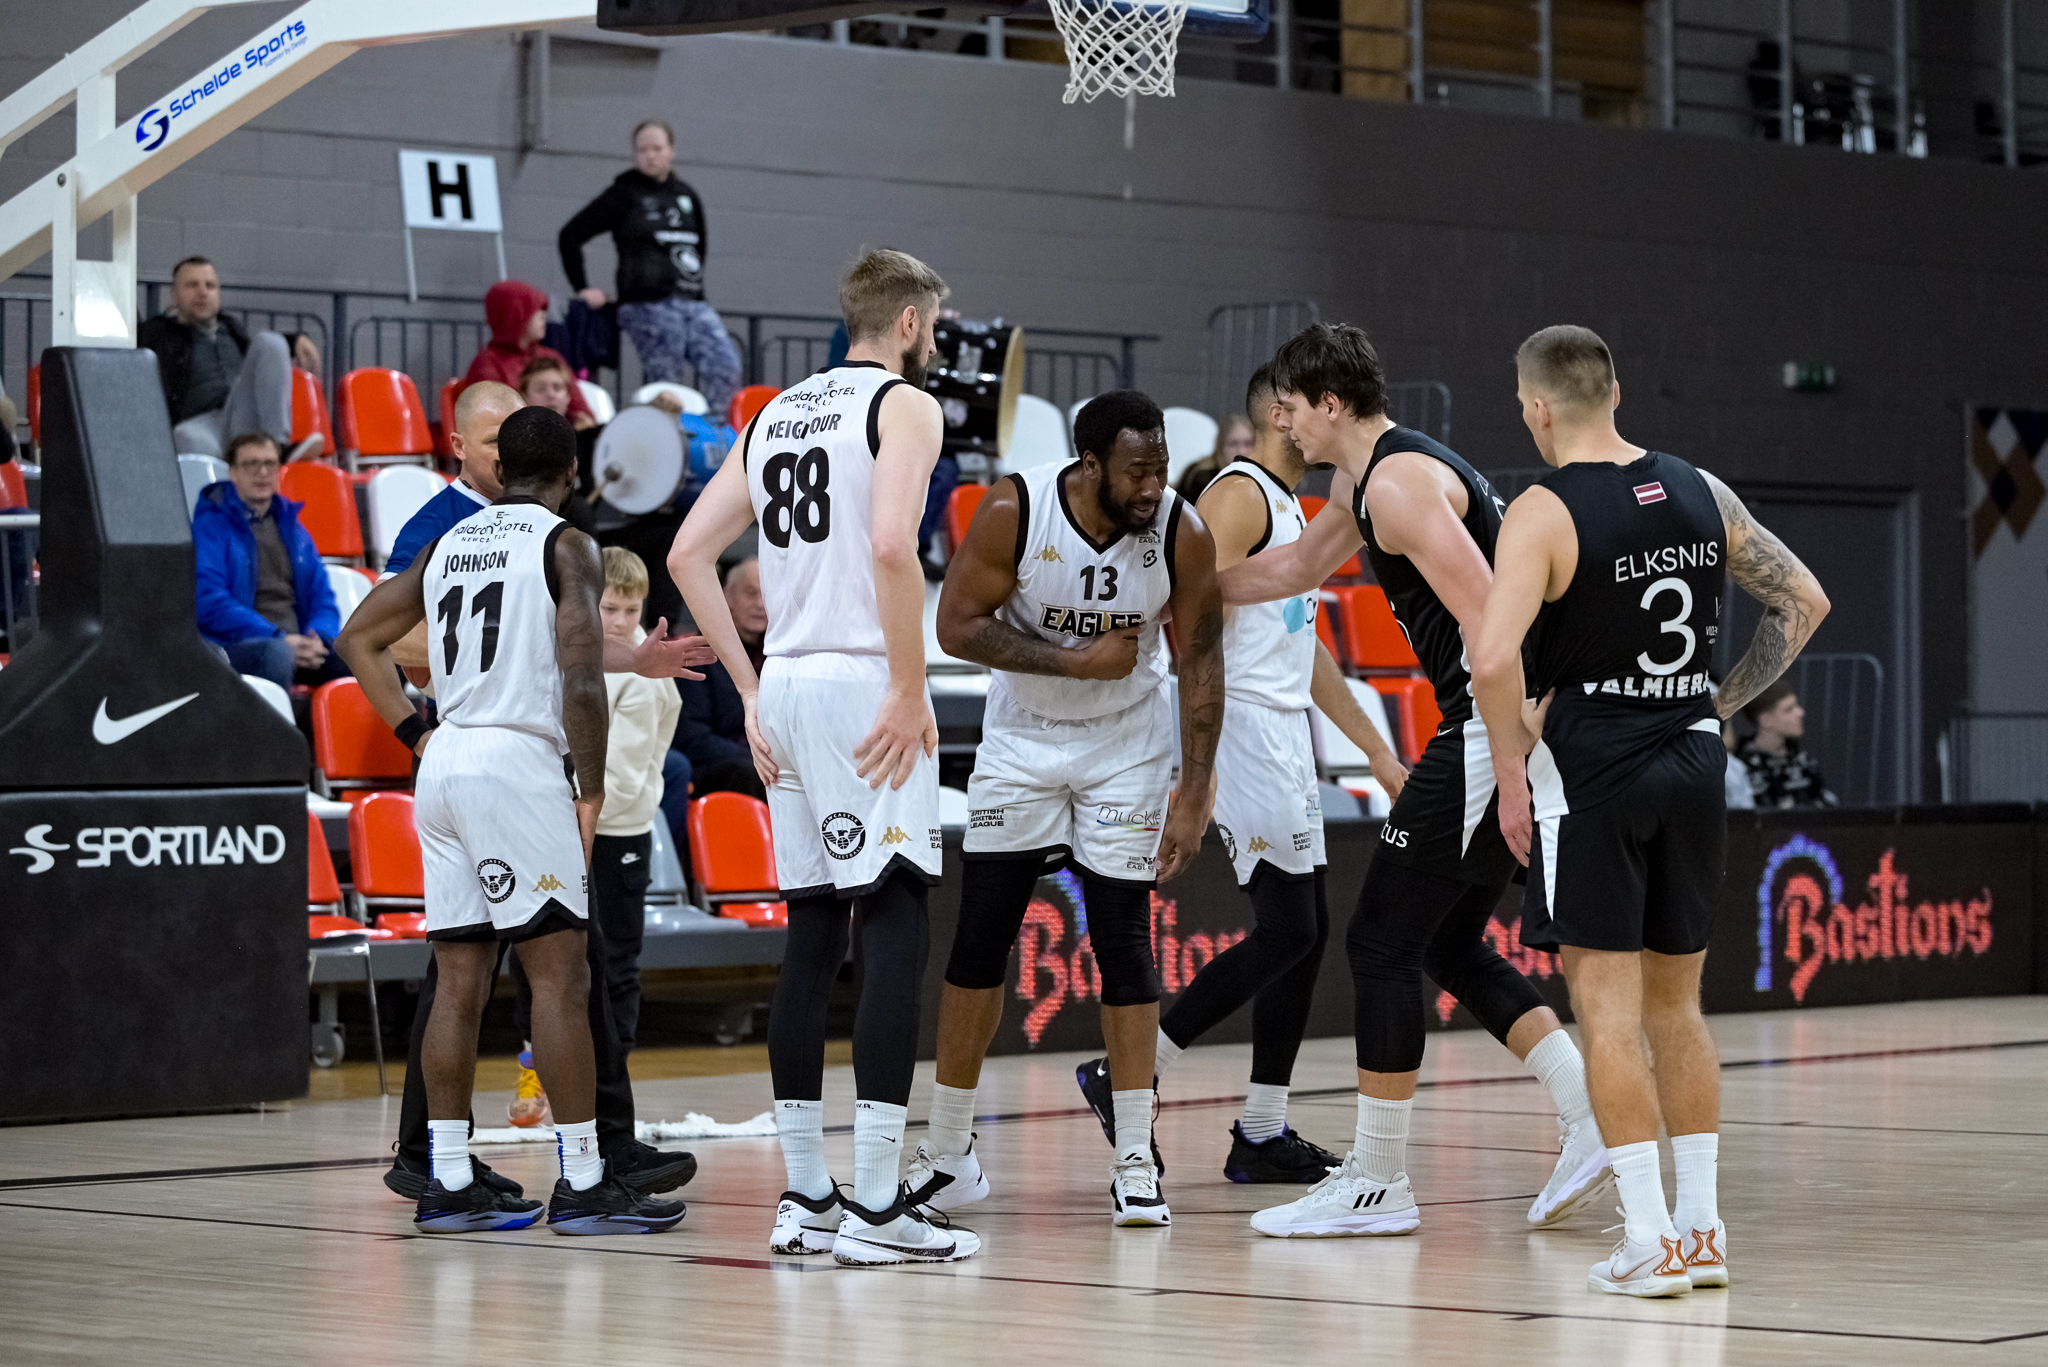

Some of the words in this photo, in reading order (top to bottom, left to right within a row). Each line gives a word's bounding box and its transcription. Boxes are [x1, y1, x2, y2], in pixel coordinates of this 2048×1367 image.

[169, 62, 242, 119] Schelde
[244, 20, 306, 69] Sports
[427, 161, 474, 220] H
[762, 446, 830, 548] 88
[443, 551, 509, 579] JOHNSON
[1080, 565, 1118, 601] 13
[1615, 541, 1718, 583] ELKSNIS
[438, 581, 504, 676] 11
[1637, 577, 1696, 676] 3
[77, 825, 286, 868] SPORTLAND
[1778, 849, 1993, 1000] Bastions
